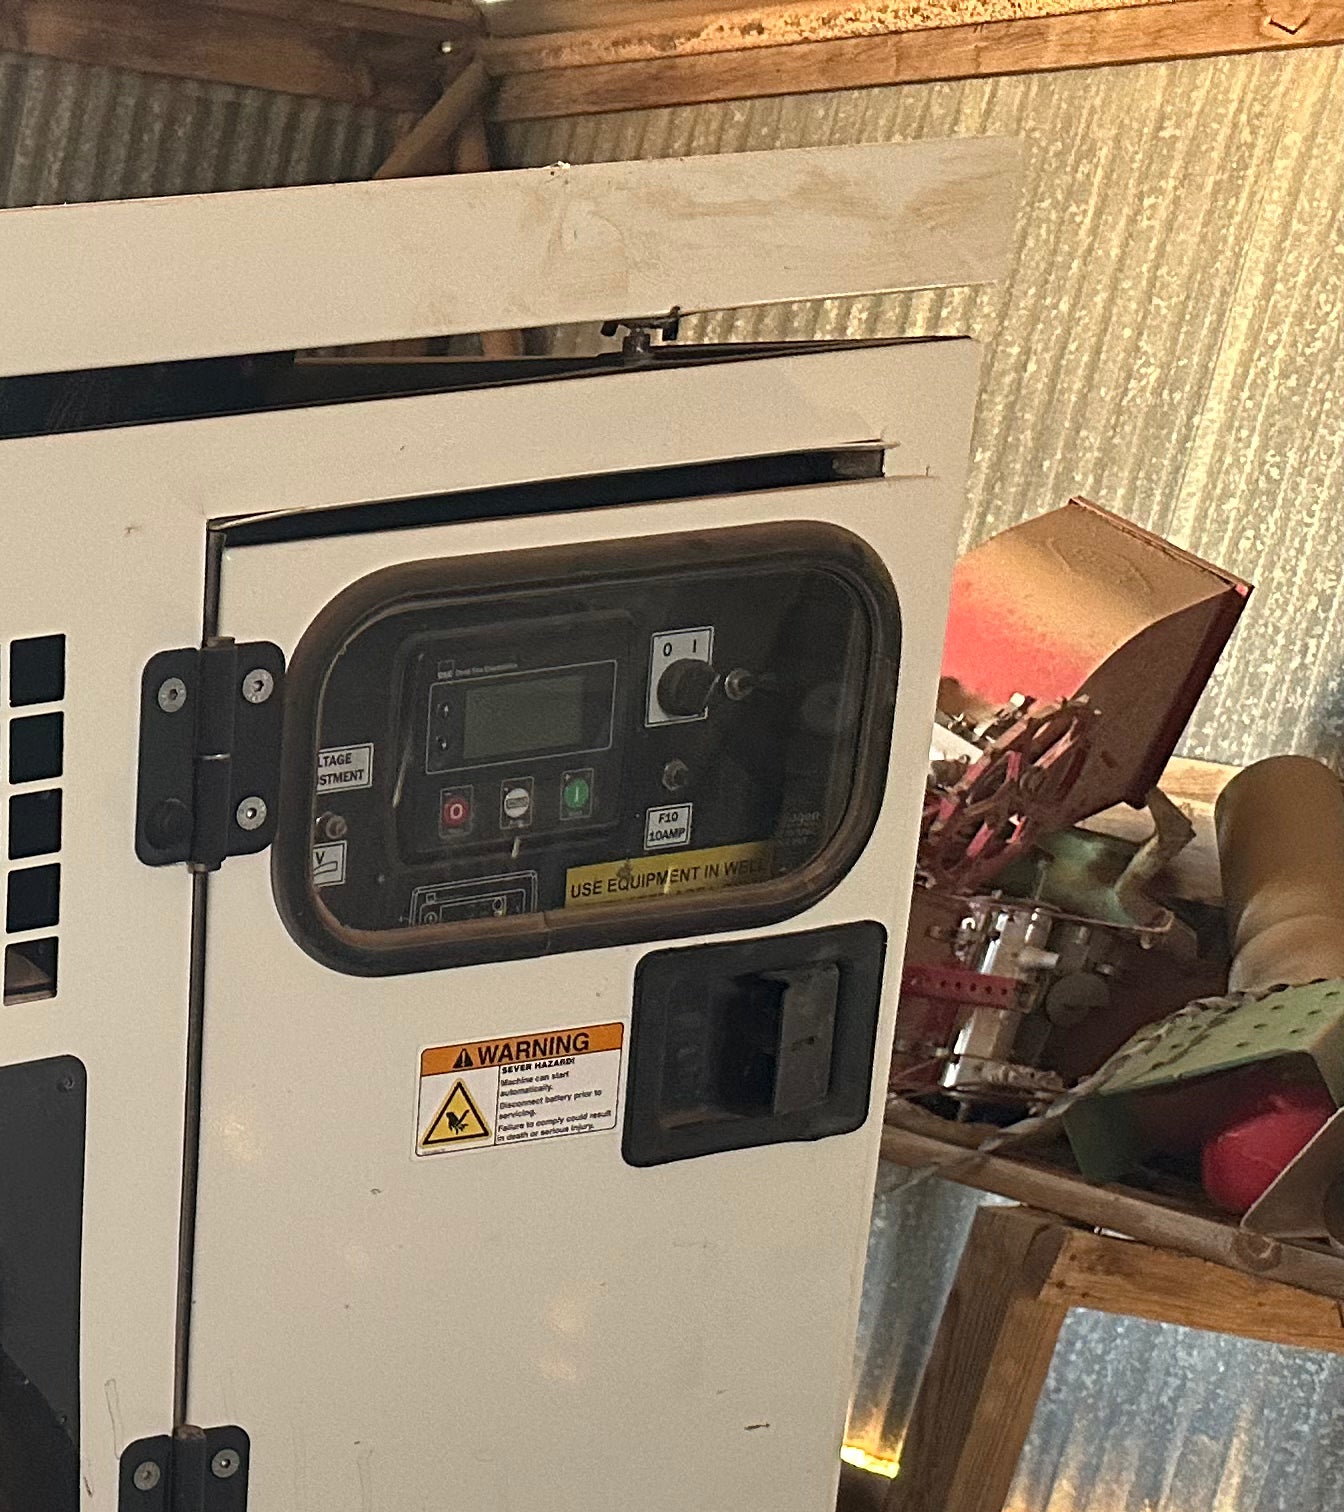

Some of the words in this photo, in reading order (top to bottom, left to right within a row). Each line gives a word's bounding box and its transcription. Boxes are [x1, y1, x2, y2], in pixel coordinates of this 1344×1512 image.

[318, 753, 353, 768] LTAGE
[319, 769, 365, 785] STMENT
[658, 811, 679, 824] F10
[648, 827, 686, 841] 10AMP
[571, 880, 603, 898] USE
[607, 866, 701, 893] EQUIPMENT
[704, 863, 720, 878] IN
[478, 1032, 590, 1066] WARNING
[502, 1063, 533, 1074] SEVER
[501, 1075, 534, 1087] Machine
[534, 1073, 550, 1082] can
[551, 1070, 570, 1080] start
[545, 1093, 573, 1105] battery
[573, 1090, 593, 1101] prior
[594, 1089, 603, 1097] to
[498, 1123, 525, 1132] Failure
[526, 1120, 535, 1128] to
[535, 1116, 565, 1127] comply
[506, 1130, 529, 1141] death
